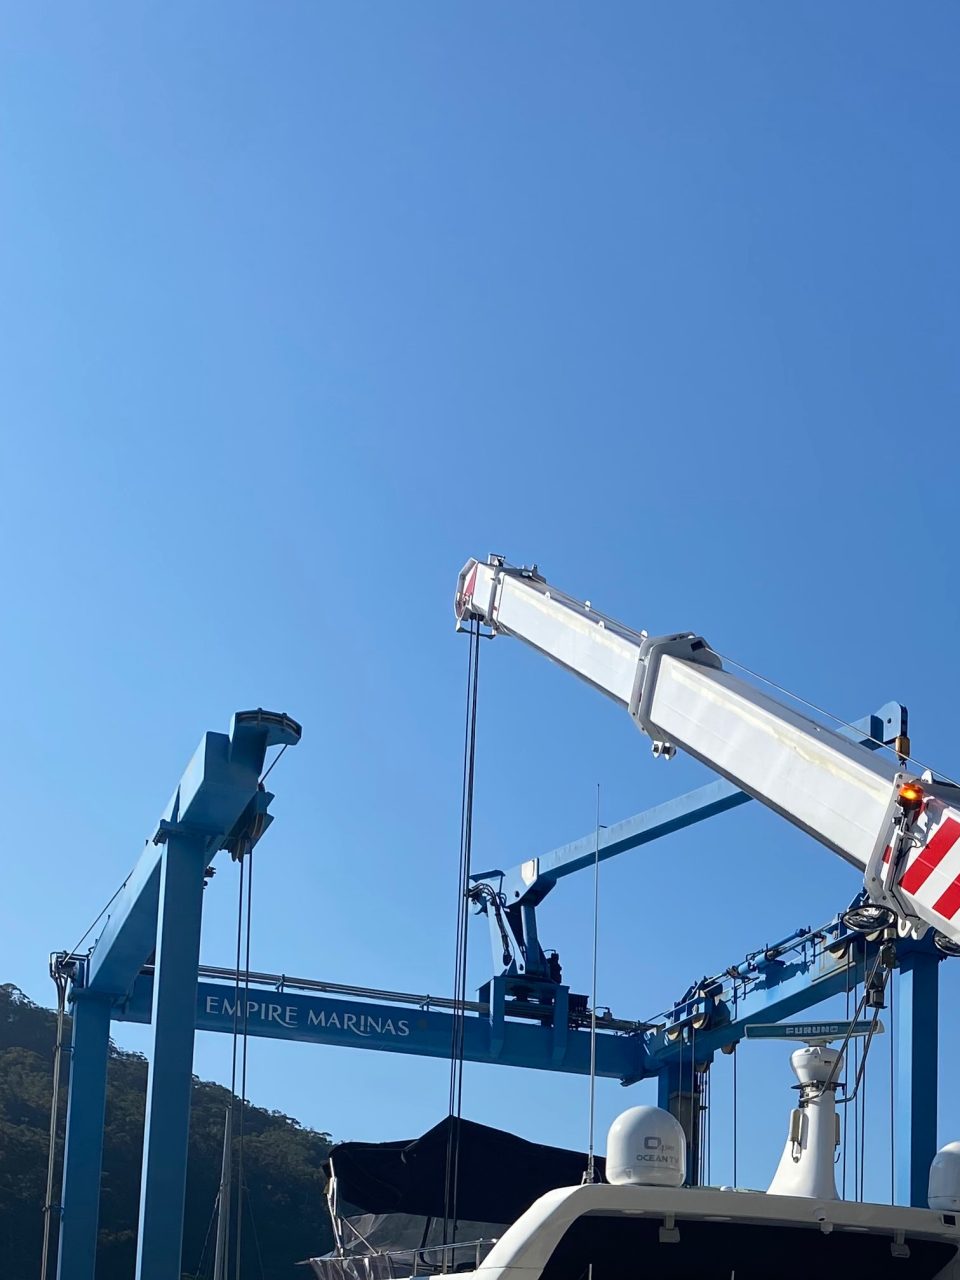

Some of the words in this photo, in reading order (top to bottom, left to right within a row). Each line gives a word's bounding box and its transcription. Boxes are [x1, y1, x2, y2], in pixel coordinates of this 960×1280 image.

[206, 996, 299, 1028] EMPIRE
[307, 1009, 410, 1037] MARINAS
[785, 1026, 838, 1035] FURUNO
[636, 1154, 668, 1163] OCEAN
